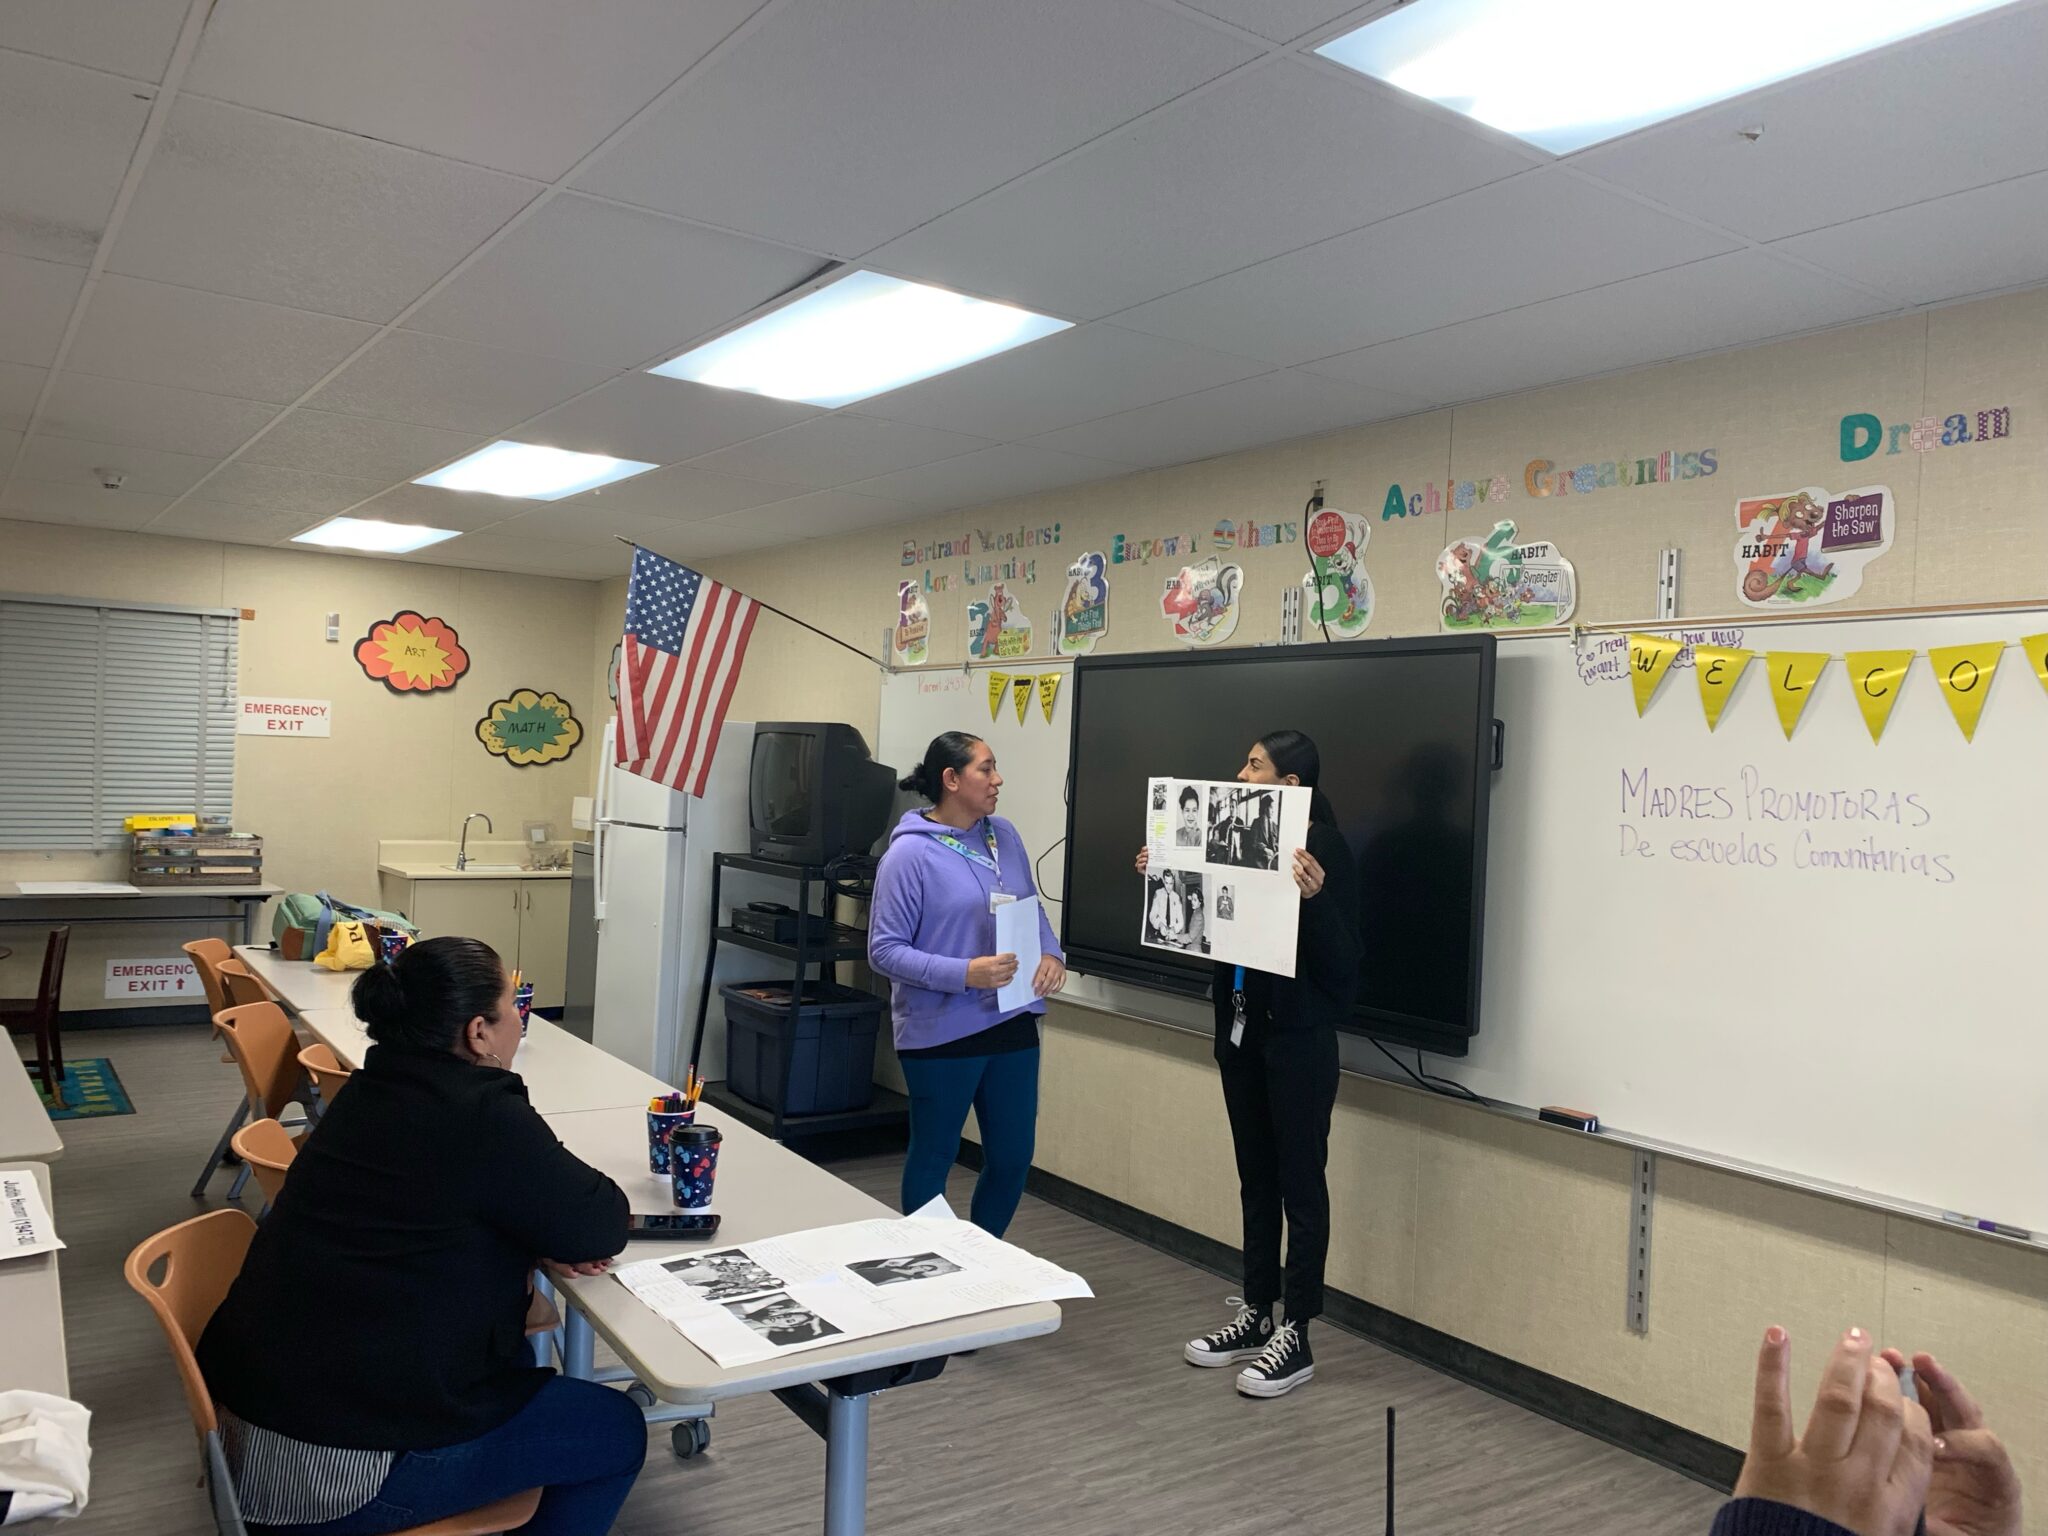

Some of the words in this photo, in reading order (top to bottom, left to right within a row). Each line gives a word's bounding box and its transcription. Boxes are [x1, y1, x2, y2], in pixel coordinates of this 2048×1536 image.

[1840, 406, 2010, 463] Dream
[1382, 472, 1511, 521] Achieve
[1524, 448, 1718, 497] Greatness
[1834, 503, 1879, 521] Sharpen
[1832, 521, 1850, 537] the
[901, 535, 971, 567] Bertrand
[1112, 533, 1200, 566] Empower
[1213, 518, 1297, 552] Others
[1742, 543, 1789, 558] HABIT
[1511, 545, 1549, 560] HABIT
[924, 569, 958, 593] Love
[1523, 570, 1559, 588] Synergize
[1595, 635, 1629, 655] Treat
[1681, 630, 1705, 647] how
[404, 646, 427, 658] ART
[1585, 657, 1621, 678] want
[244, 703, 328, 717] EMERGENCY
[267, 719, 304, 731] EXIT
[508, 722, 546, 734] MATH
[1621, 767, 1734, 819] MADRES
[1740, 764, 1932, 827] PROMOTORAS
[1619, 824, 1656, 858] De
[1670, 831, 1778, 867] escuelas
[1793, 829, 1956, 883] Comunitarias
[112, 964, 194, 977] EMERGENC
[128, 980, 168, 992] EXIT
